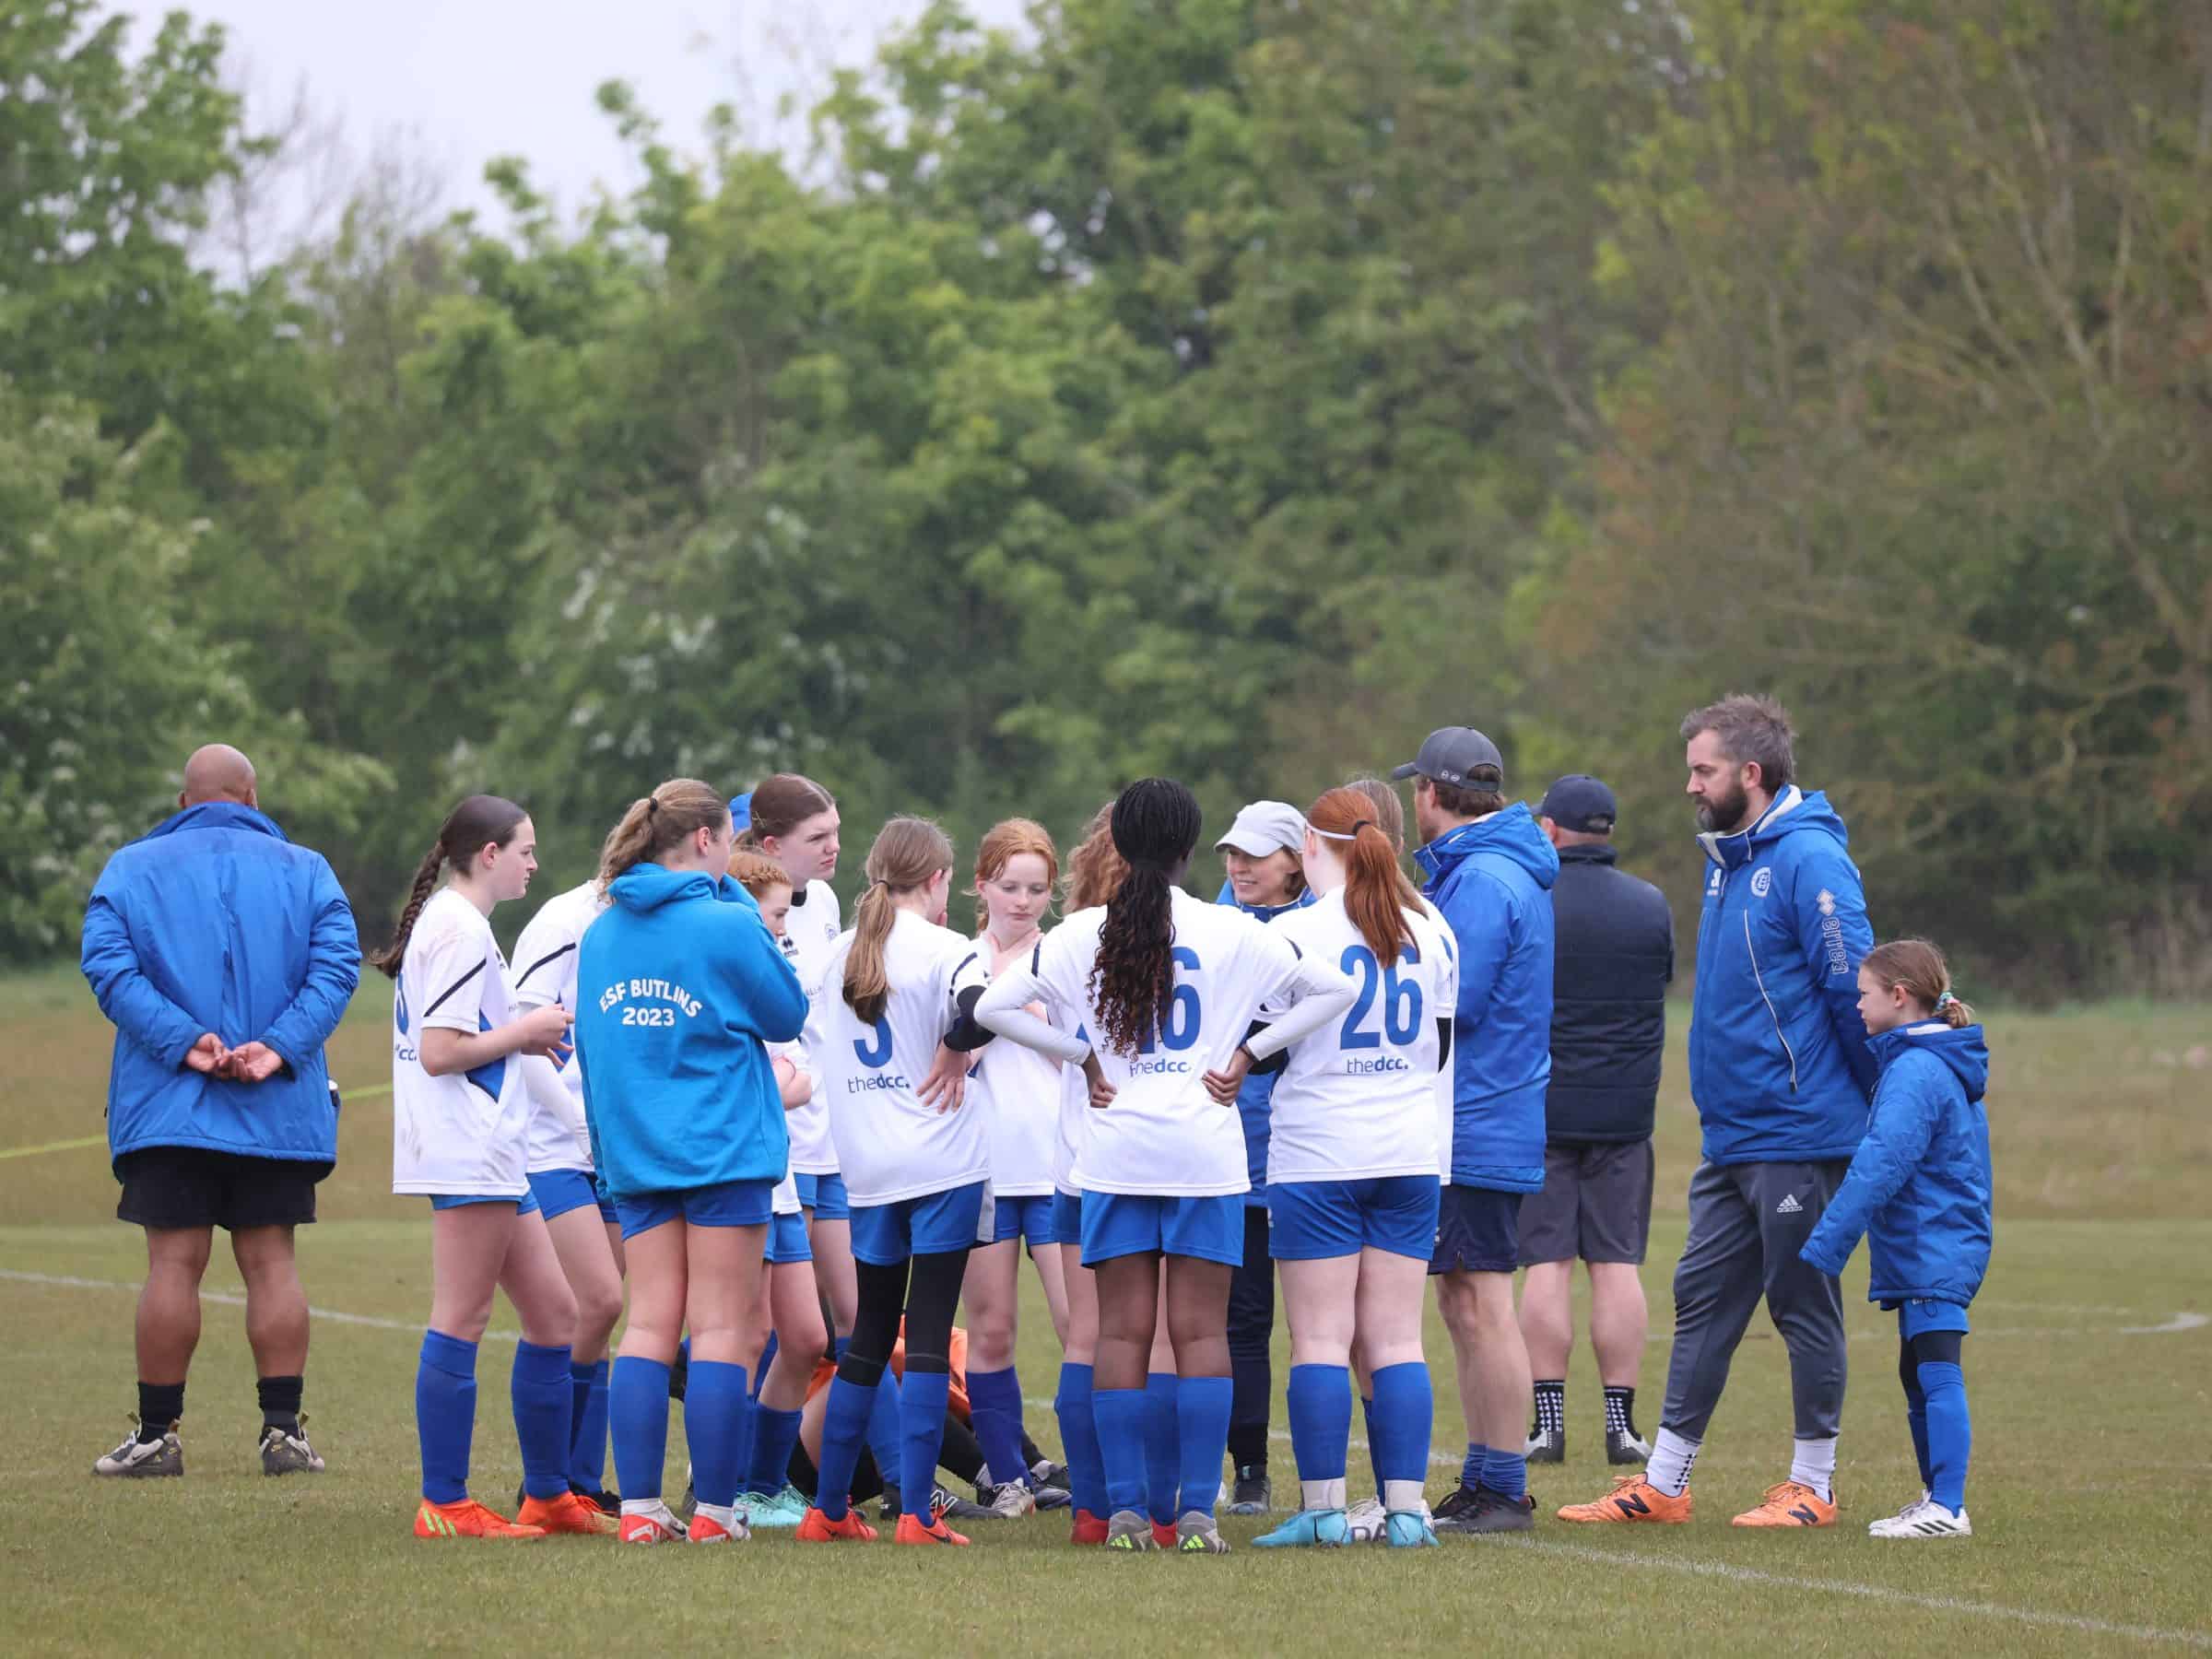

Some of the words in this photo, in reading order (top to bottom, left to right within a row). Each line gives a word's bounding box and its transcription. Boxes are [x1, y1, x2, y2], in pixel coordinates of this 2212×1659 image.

[599, 982, 627, 1015] ESF
[630, 978, 703, 1018] BUTLINS
[1340, 942, 1423, 1051] 26
[621, 1006, 676, 1026] 2023
[1347, 1055, 1409, 1074] thedcc.
[847, 1073, 911, 1093] thedcc.
